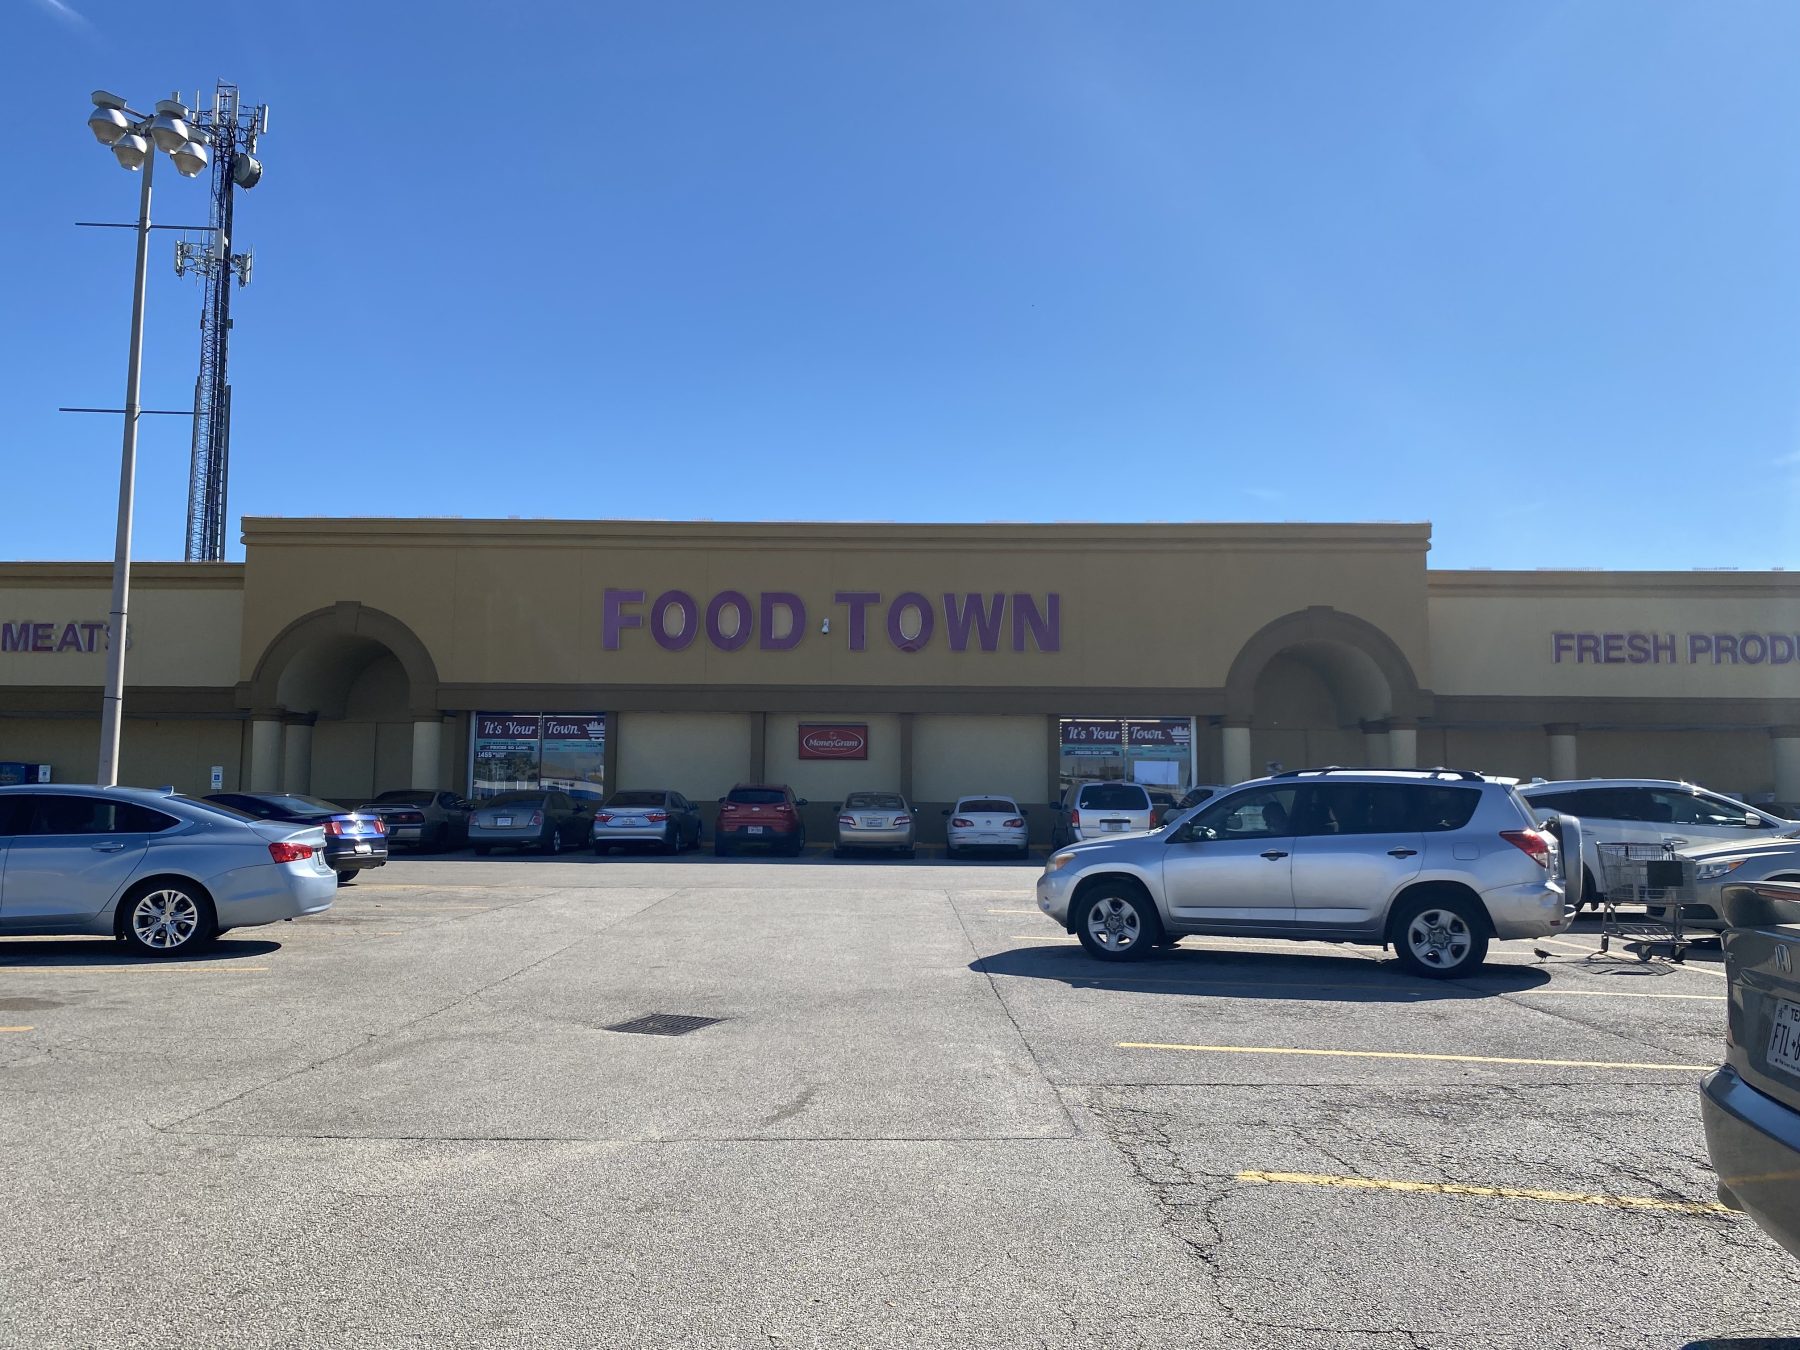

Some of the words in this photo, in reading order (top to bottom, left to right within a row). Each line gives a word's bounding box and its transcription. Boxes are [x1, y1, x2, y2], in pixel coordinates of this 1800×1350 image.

[601, 588, 806, 651] FOOD
[835, 591, 1061, 652] TOWN
[1, 623, 132, 652] MEAT
[1552, 632, 1676, 664] FRESH
[484, 721, 503, 734] It's
[506, 721, 535, 735] Your
[547, 721, 581, 734] Town.
[1068, 726, 1087, 739] It's
[1089, 726, 1120, 740] Your
[1131, 726, 1165, 740] Town.
[809, 739, 858, 747] MoneyGram
